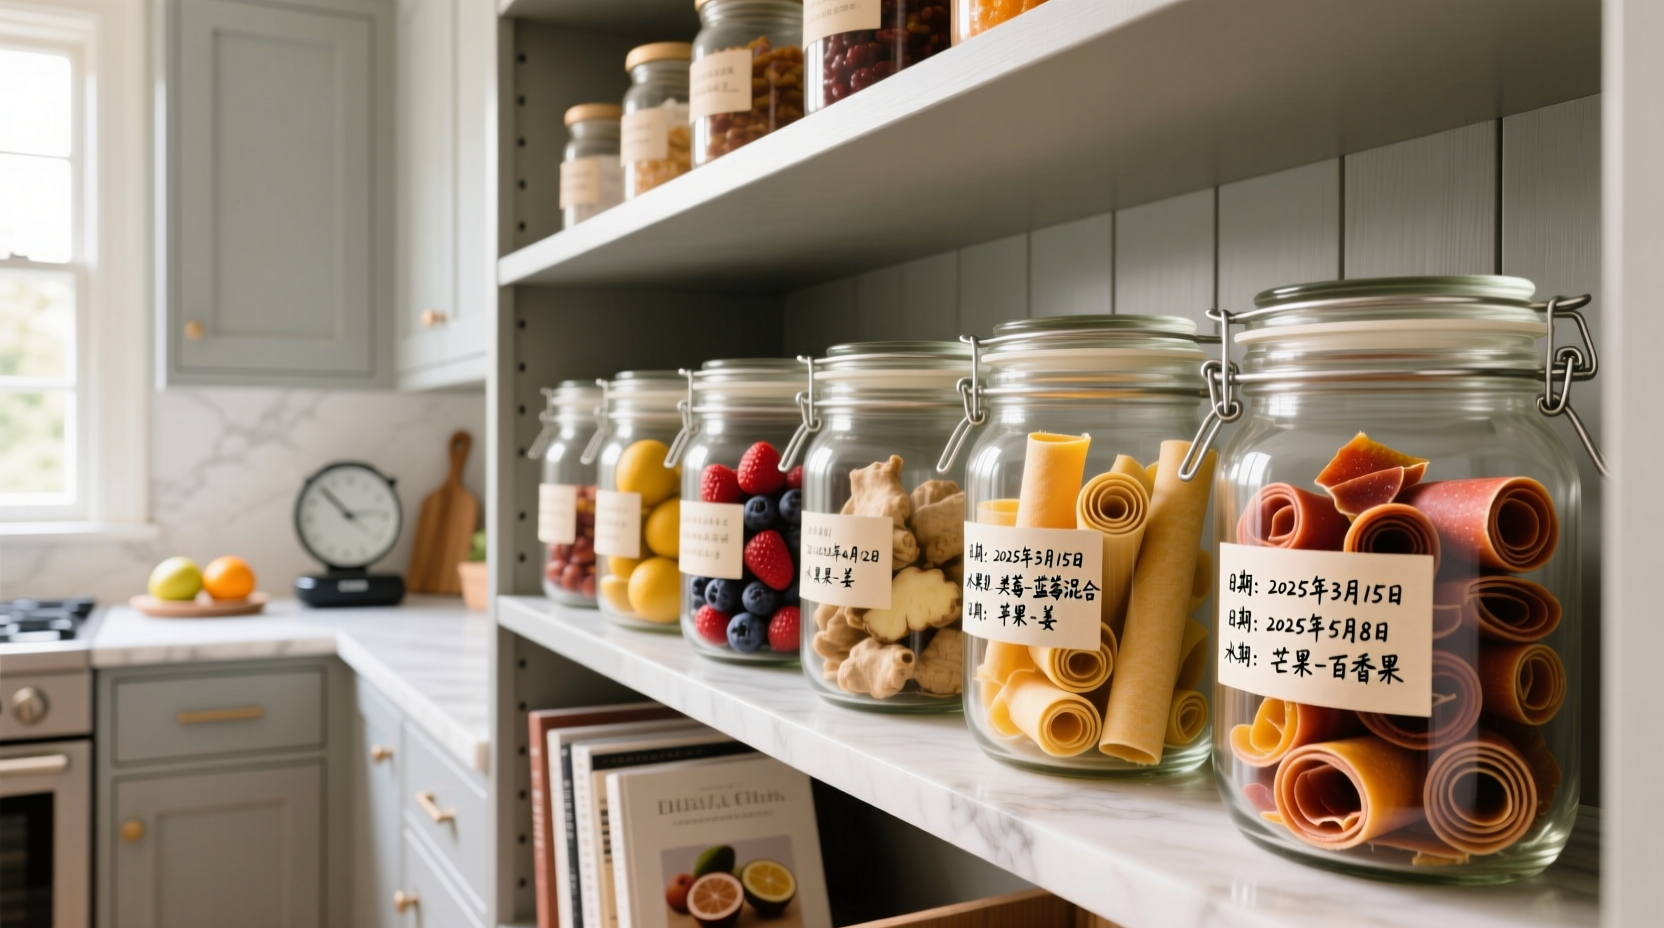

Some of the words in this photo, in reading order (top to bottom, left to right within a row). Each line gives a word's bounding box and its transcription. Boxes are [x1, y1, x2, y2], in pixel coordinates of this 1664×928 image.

[1268, 575, 1403, 606] 2025年3月15日
[1266, 613, 1389, 643] 2025年5月8日
[1270, 646, 1404, 685] 芒果-百香果
